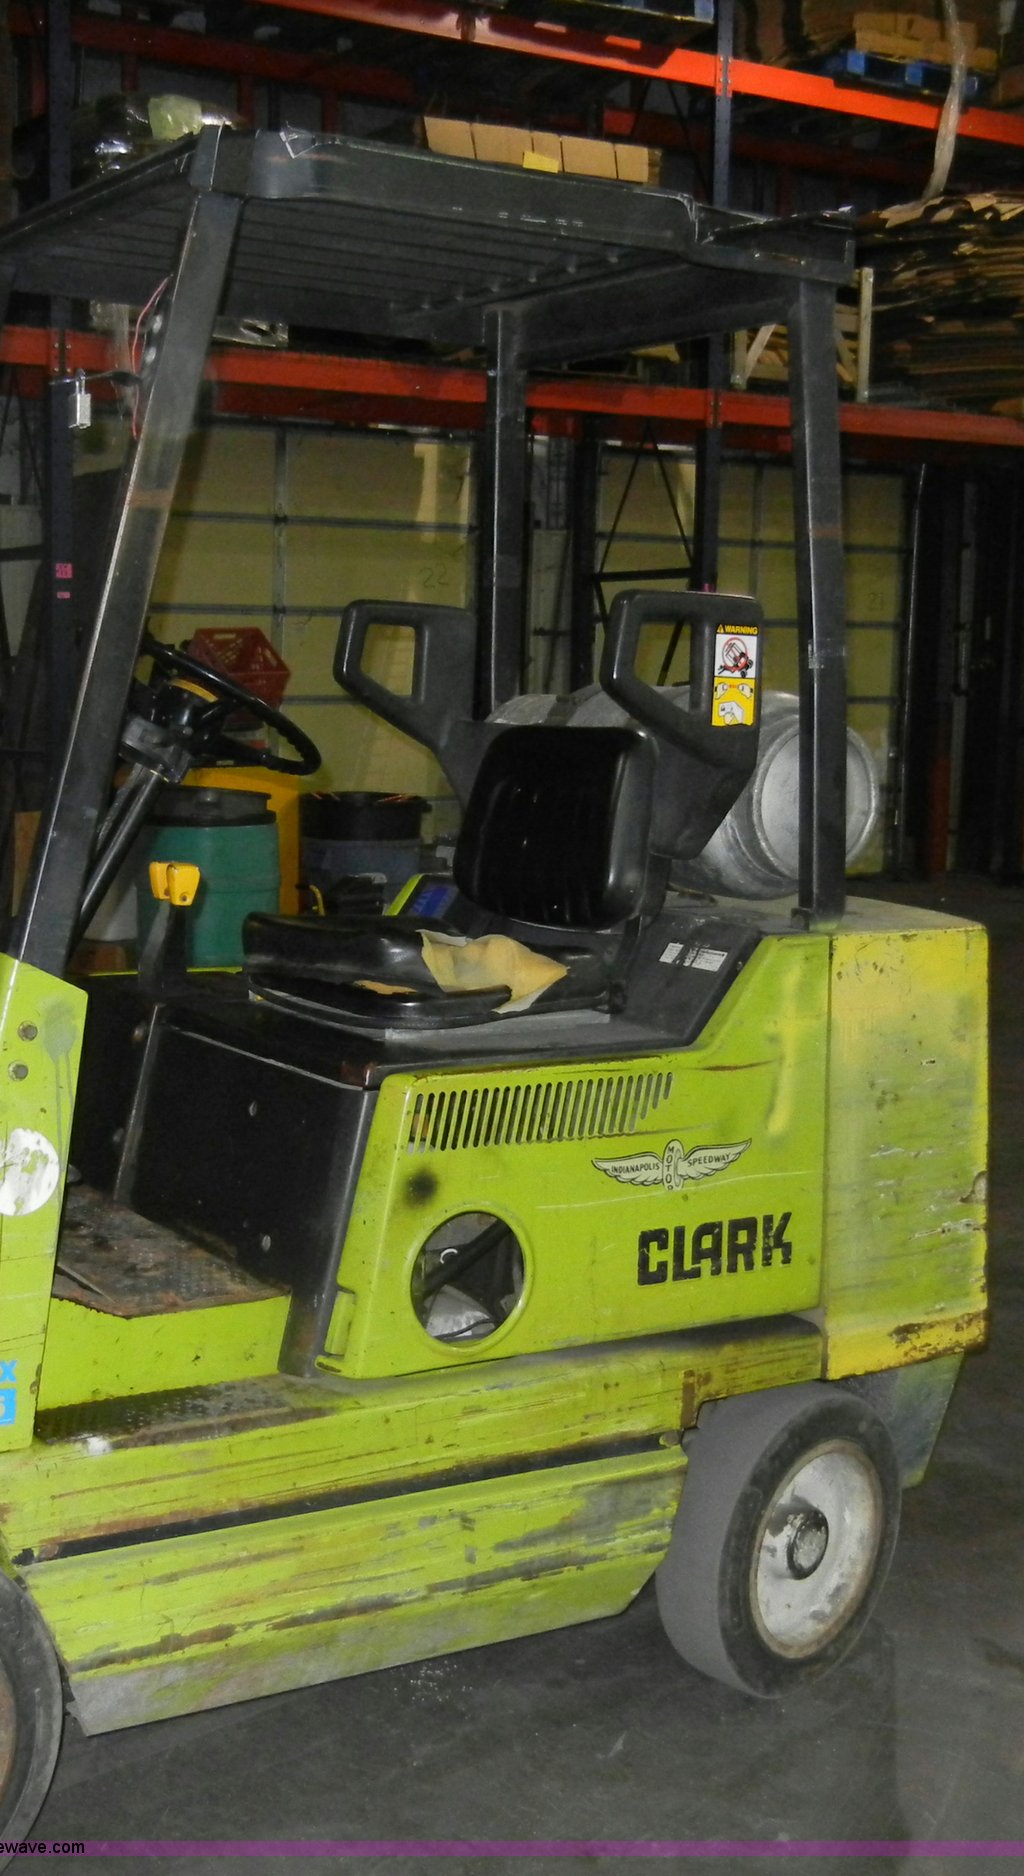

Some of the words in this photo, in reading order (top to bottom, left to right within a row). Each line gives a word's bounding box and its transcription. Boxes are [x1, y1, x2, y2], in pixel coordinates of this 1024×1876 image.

[418, 562, 450, 589] 22
[724, 625, 758, 635] WARNING
[610, 1162, 660, 1174] INDIANAPOLIS
[687, 1153, 731, 1168] SPEEDWAY
[637, 1212, 792, 1286] CLARK
